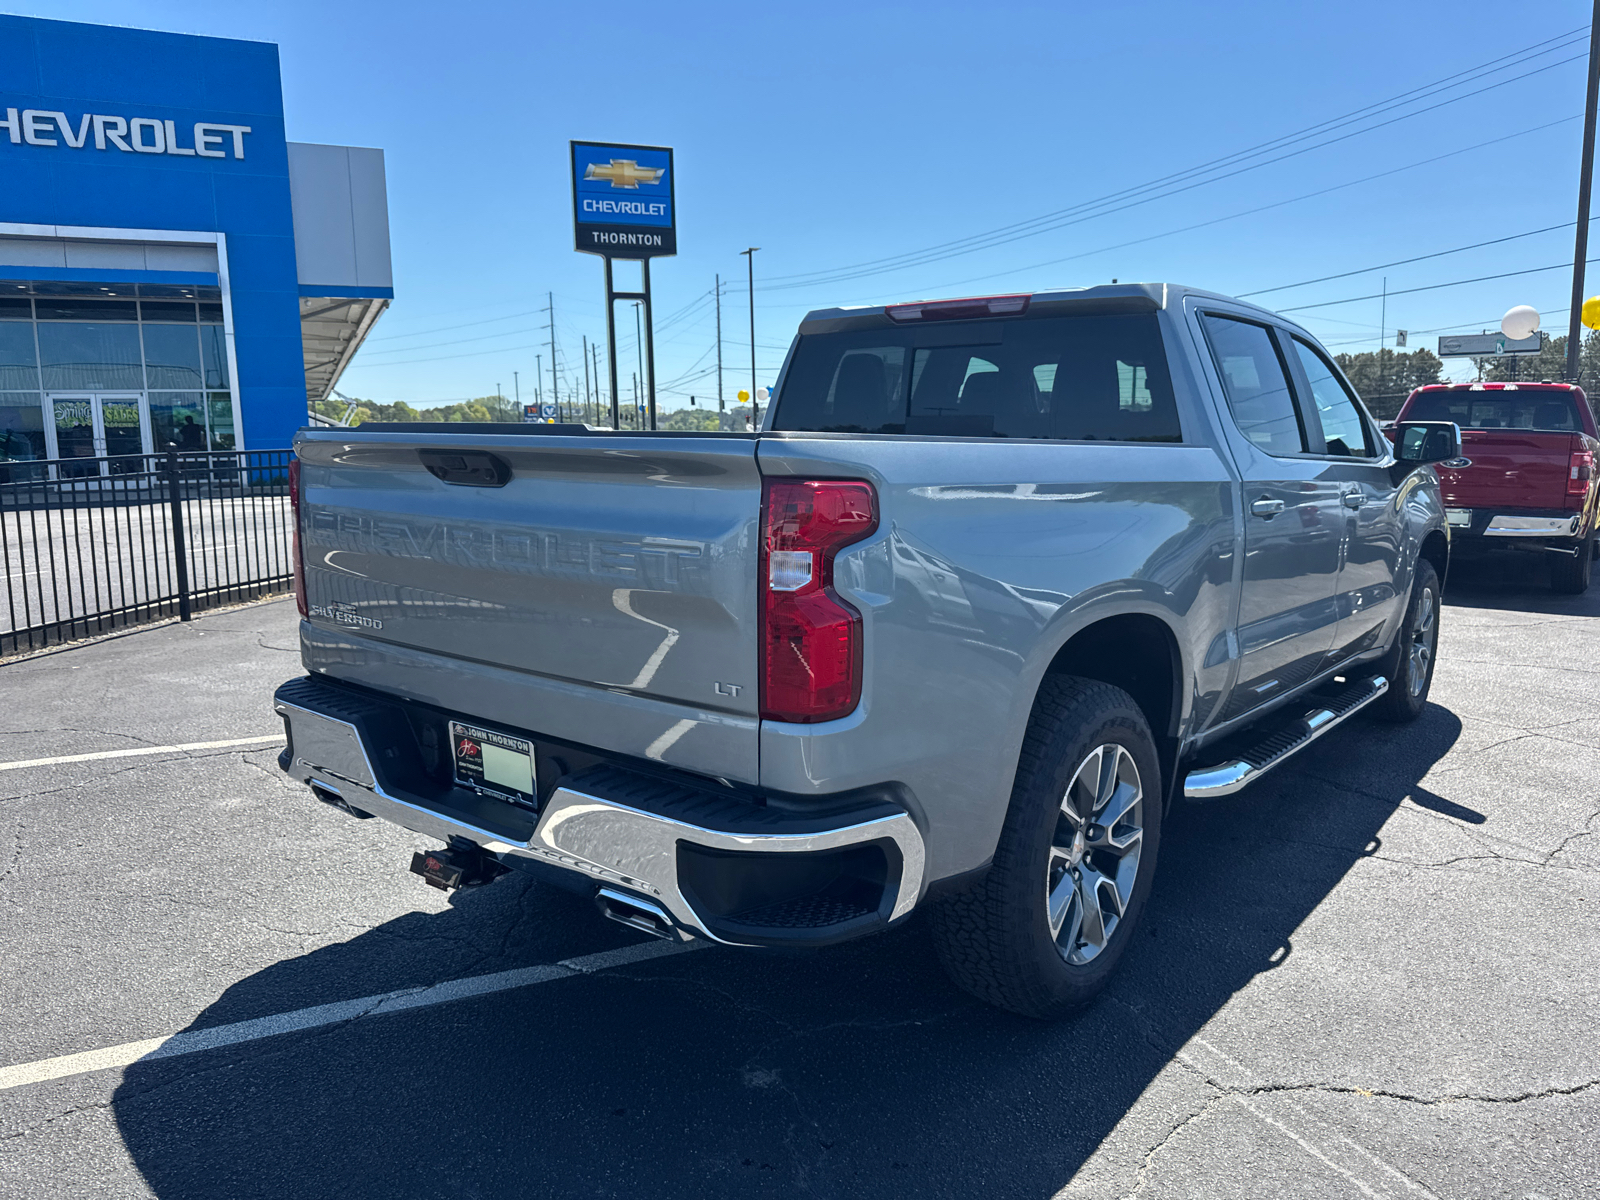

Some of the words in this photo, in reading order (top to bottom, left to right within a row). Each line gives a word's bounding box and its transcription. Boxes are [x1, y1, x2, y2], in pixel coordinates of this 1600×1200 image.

[0, 107, 252, 160] HEVROLET
[583, 199, 667, 216] CHEVROLET
[592, 231, 662, 246] THORNTON
[311, 511, 705, 584] CHEVROLET
[310, 604, 383, 630] SILVERADO
[714, 681, 743, 697] LT
[468, 728, 487, 739] JOHN
[488, 733, 529, 751] THORNTON
